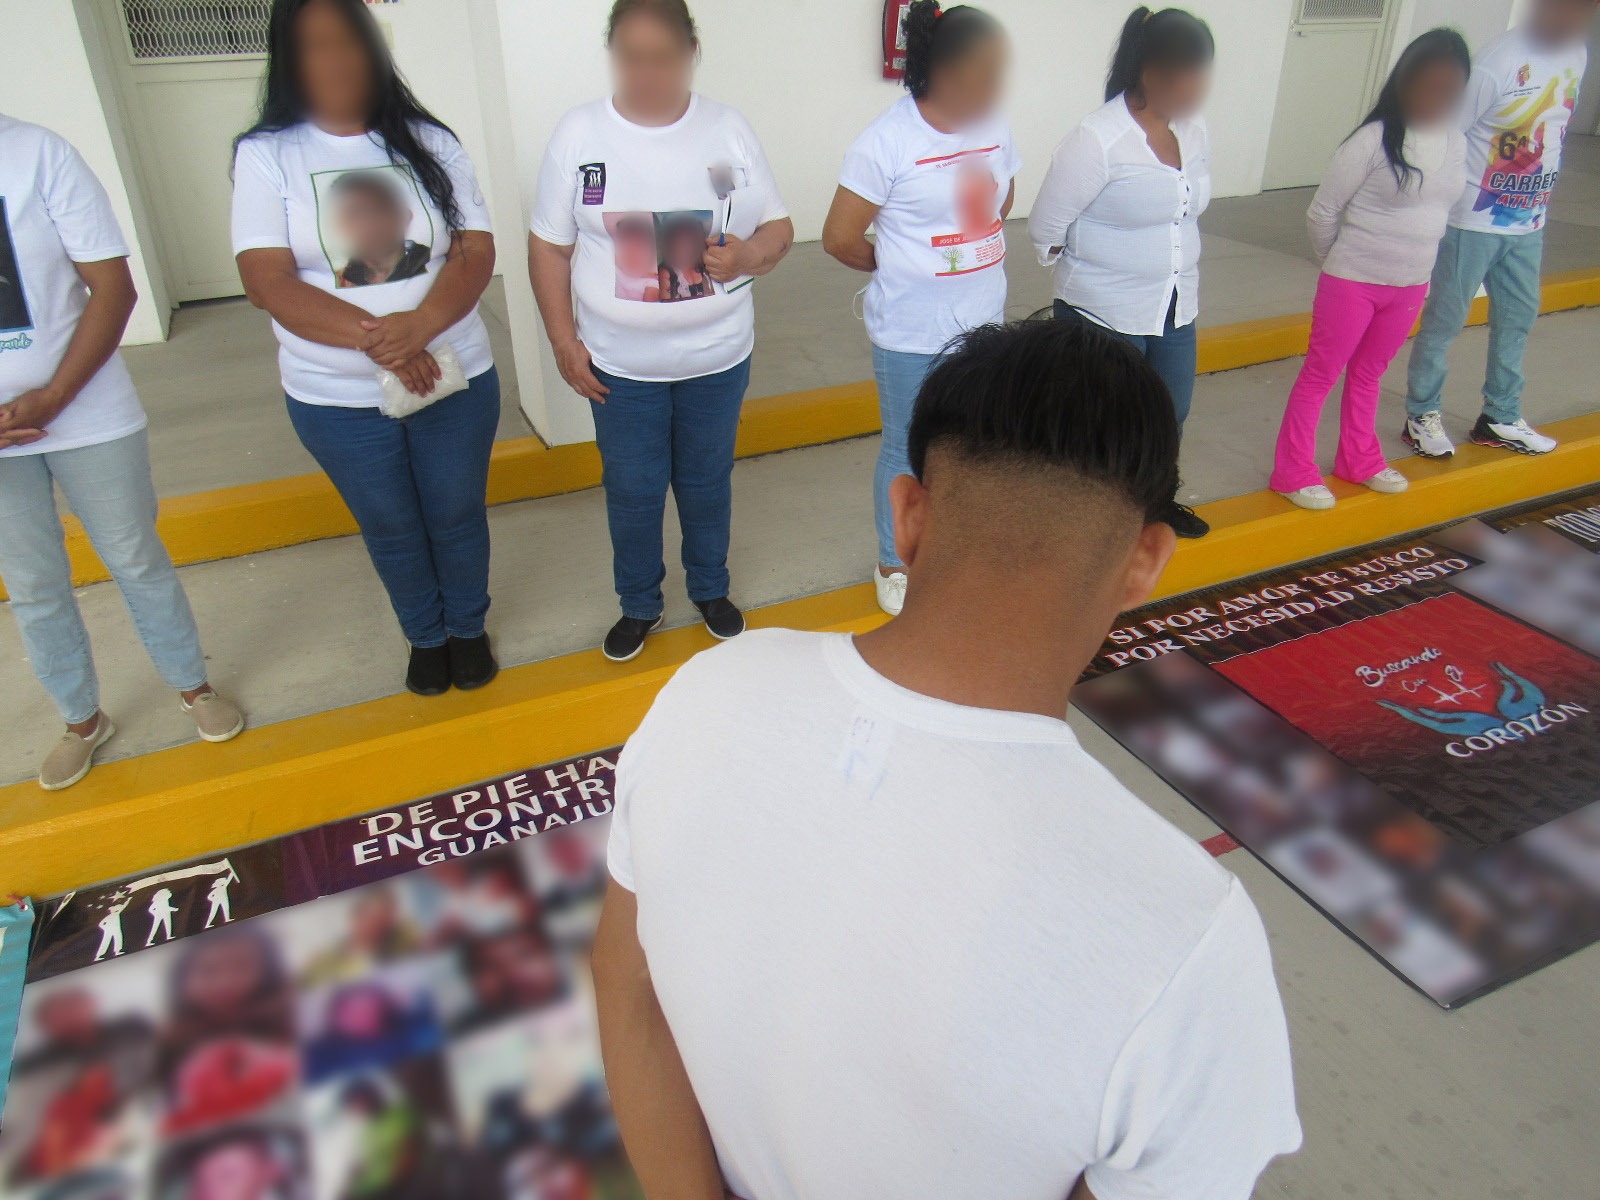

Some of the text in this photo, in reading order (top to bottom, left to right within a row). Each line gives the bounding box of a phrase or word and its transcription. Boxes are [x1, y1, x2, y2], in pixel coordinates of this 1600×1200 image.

[1105, 557, 1469, 668] POR NECESIDAD RESISTO
[1107, 546, 1436, 646] SI POR AMOR TE BUSCO
[1355, 646, 1442, 688] Buscando
[1401, 678, 1428, 693] Con
[1445, 701, 1590, 758] CORAZÓN
[352, 777, 612, 867] ENCONTR
[366, 752, 620, 837] DE PIE HA
[417, 798, 613, 867] GUANAJU
